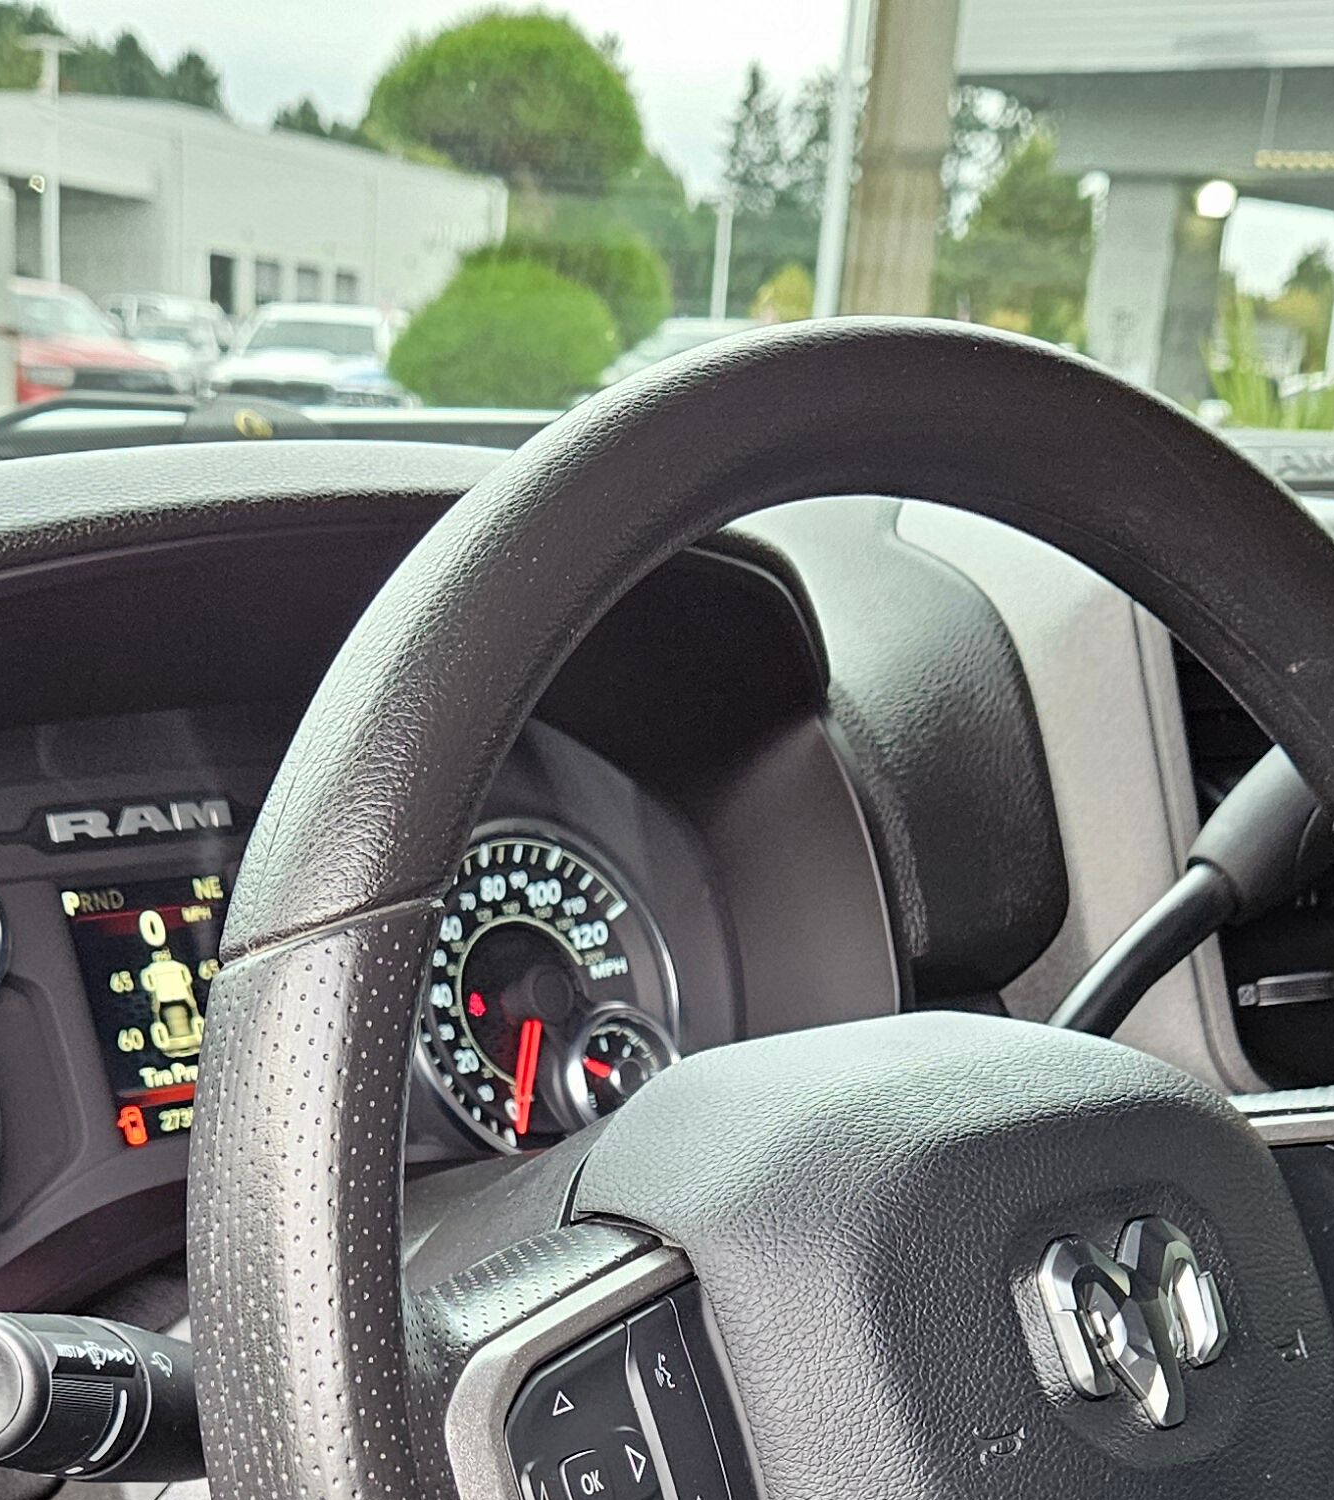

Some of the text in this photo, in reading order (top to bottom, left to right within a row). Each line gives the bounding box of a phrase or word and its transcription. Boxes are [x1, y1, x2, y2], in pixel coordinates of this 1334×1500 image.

[45, 799, 233, 844] RAM
[192, 876, 224, 900] NE
[479, 874, 507, 903] 80
[524, 878, 562, 909] 100
[139, 909, 166, 947] 0
[567, 920, 609, 951] 120
[589, 956, 629, 981] MPH
[117, 1027, 145, 1052] 60
[580, 1468, 603, 1496] OK
